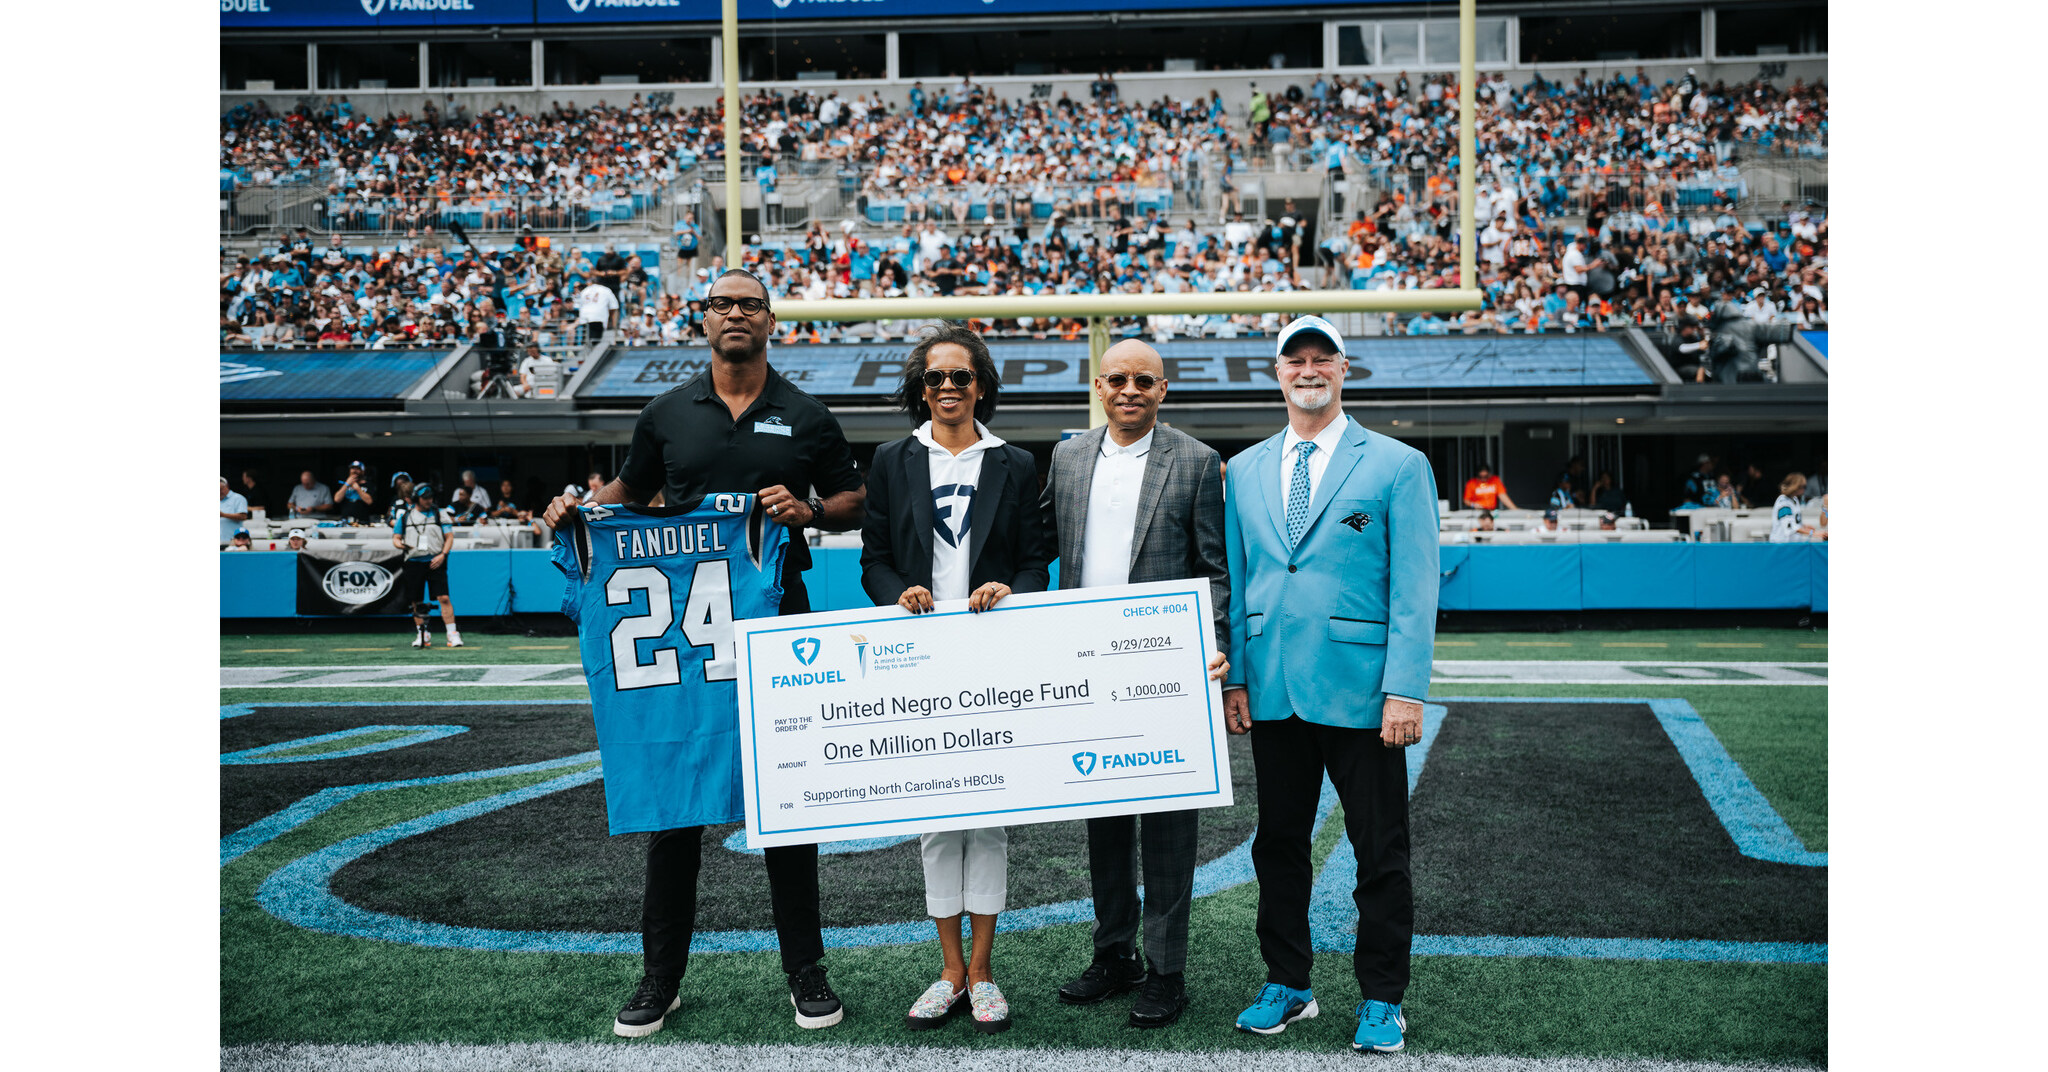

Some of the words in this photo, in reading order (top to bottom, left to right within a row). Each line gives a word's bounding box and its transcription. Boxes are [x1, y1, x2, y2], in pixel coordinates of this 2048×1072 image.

[615, 522, 727, 560] FANDUEL
[338, 570, 377, 587] FOX
[339, 587, 379, 595] SPORTS
[1123, 605, 1160, 617] CHECK
[1162, 603, 1188, 614] #004
[604, 558, 738, 692] 24
[873, 642, 914, 656] UNCF
[1077, 650, 1095, 658] DATE
[1111, 636, 1172, 651] 9/29/2024
[771, 670, 846, 689] FANDUEL
[821, 697, 885, 721] United
[892, 696, 952, 716] Negro
[958, 687, 1034, 708] College
[1040, 679, 1090, 701] Fund
[1111, 690, 1118, 702] $
[1125, 682, 1181, 698] 1,000,000
[774, 718, 788, 726] PAY
[789, 717, 798, 725] TO
[775, 725, 798, 733] ORDER
[823, 742, 863, 760] One
[870, 735, 936, 756] Million
[943, 728, 1014, 749] Dollars
[777, 761, 807, 770] AMOUNT
[1102, 749, 1185, 770] FANDUEL
[803, 787, 866, 802] Supporting
[869, 782, 902, 796] North
[904, 777, 960, 792] Carolina's
[963, 773, 1005, 787] HBCUs
[780, 802, 794, 810] FOR
